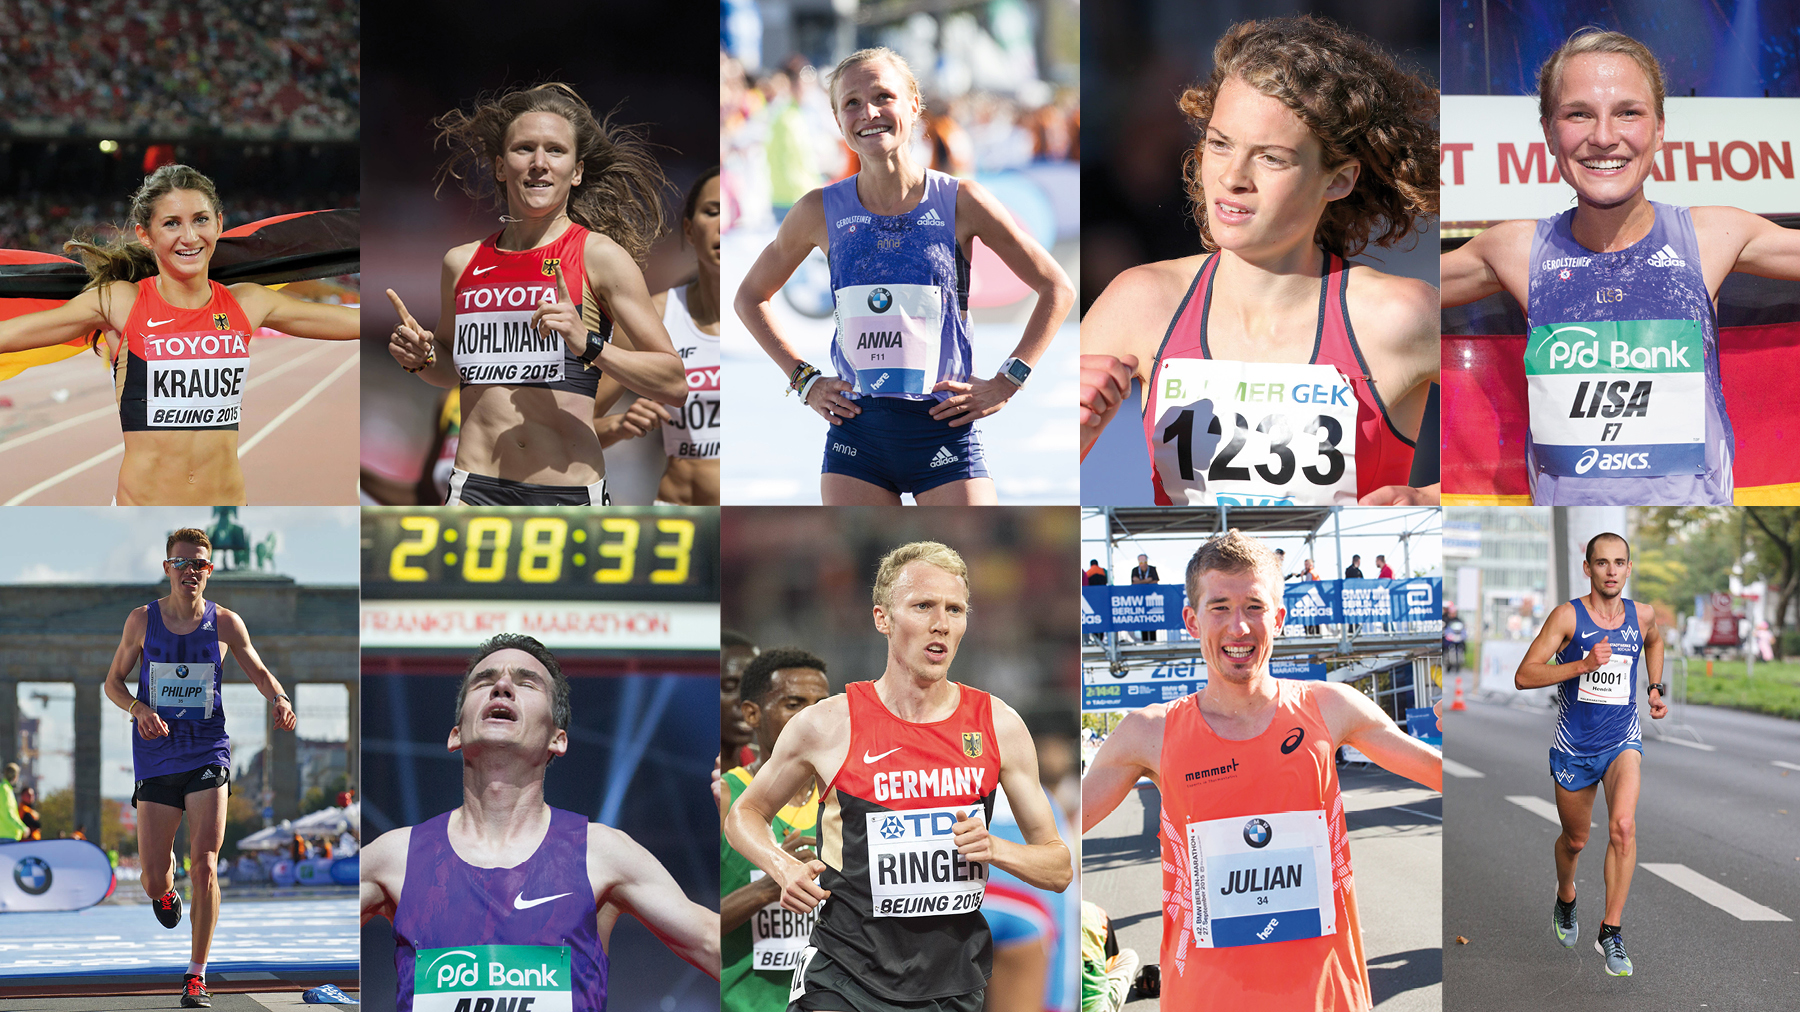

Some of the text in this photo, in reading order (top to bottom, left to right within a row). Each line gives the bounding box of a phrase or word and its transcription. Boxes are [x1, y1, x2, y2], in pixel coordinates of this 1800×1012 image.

[1441, 142, 1474, 186] T
[917, 218, 945, 227] adidas
[1542, 255, 1591, 271] GEROLSTEINER
[1647, 256, 1686, 268] adidas
[462, 286, 558, 309] TOYOTA
[149, 334, 246, 356] TOYOTA
[457, 322, 558, 355] KOHLMANN
[856, 331, 903, 350] ANNA
[871, 353, 885, 361] F11
[1549, 340, 1691, 369] psd Bank
[153, 367, 245, 399] KRAUSE
[460, 364, 560, 381] BEIJING 2015
[870, 372, 891, 391] here
[1292, 383, 1350, 407] GEK
[1569, 380, 1653, 419] LISA
[153, 407, 238, 424] BEIJING 2015
[1601, 422, 1623, 442] F7
[1163, 409, 1347, 487] 1233
[929, 454, 959, 469] adidas
[389, 516, 695, 584] 2:08:33
[1111, 596, 1143, 607] BMW
[1341, 588, 1372, 600] BMW
[522, 611, 670, 634] MARATHON
[1112, 607, 1145, 616] BERLIN
[1112, 615, 1165, 624] MARATHON
[1290, 607, 1333, 618] adidas
[1342, 608, 1391, 617] MARATHON
[1584, 671, 1622, 685] 10001
[161, 686, 203, 698] PHILIPP
[1185, 758, 1240, 782] memmert
[873, 767, 985, 802] GERMANY
[903, 808, 978, 838] TD
[878, 849, 983, 885] RINGER
[1220, 863, 1303, 897] JULIAN
[880, 891, 982, 914] BEIJING 2015
[1201, 892, 1209, 925] September
[1257, 896, 1269, 906] 34
[1255, 917, 1280, 941] here
[437, 962, 559, 989] psd Bank
